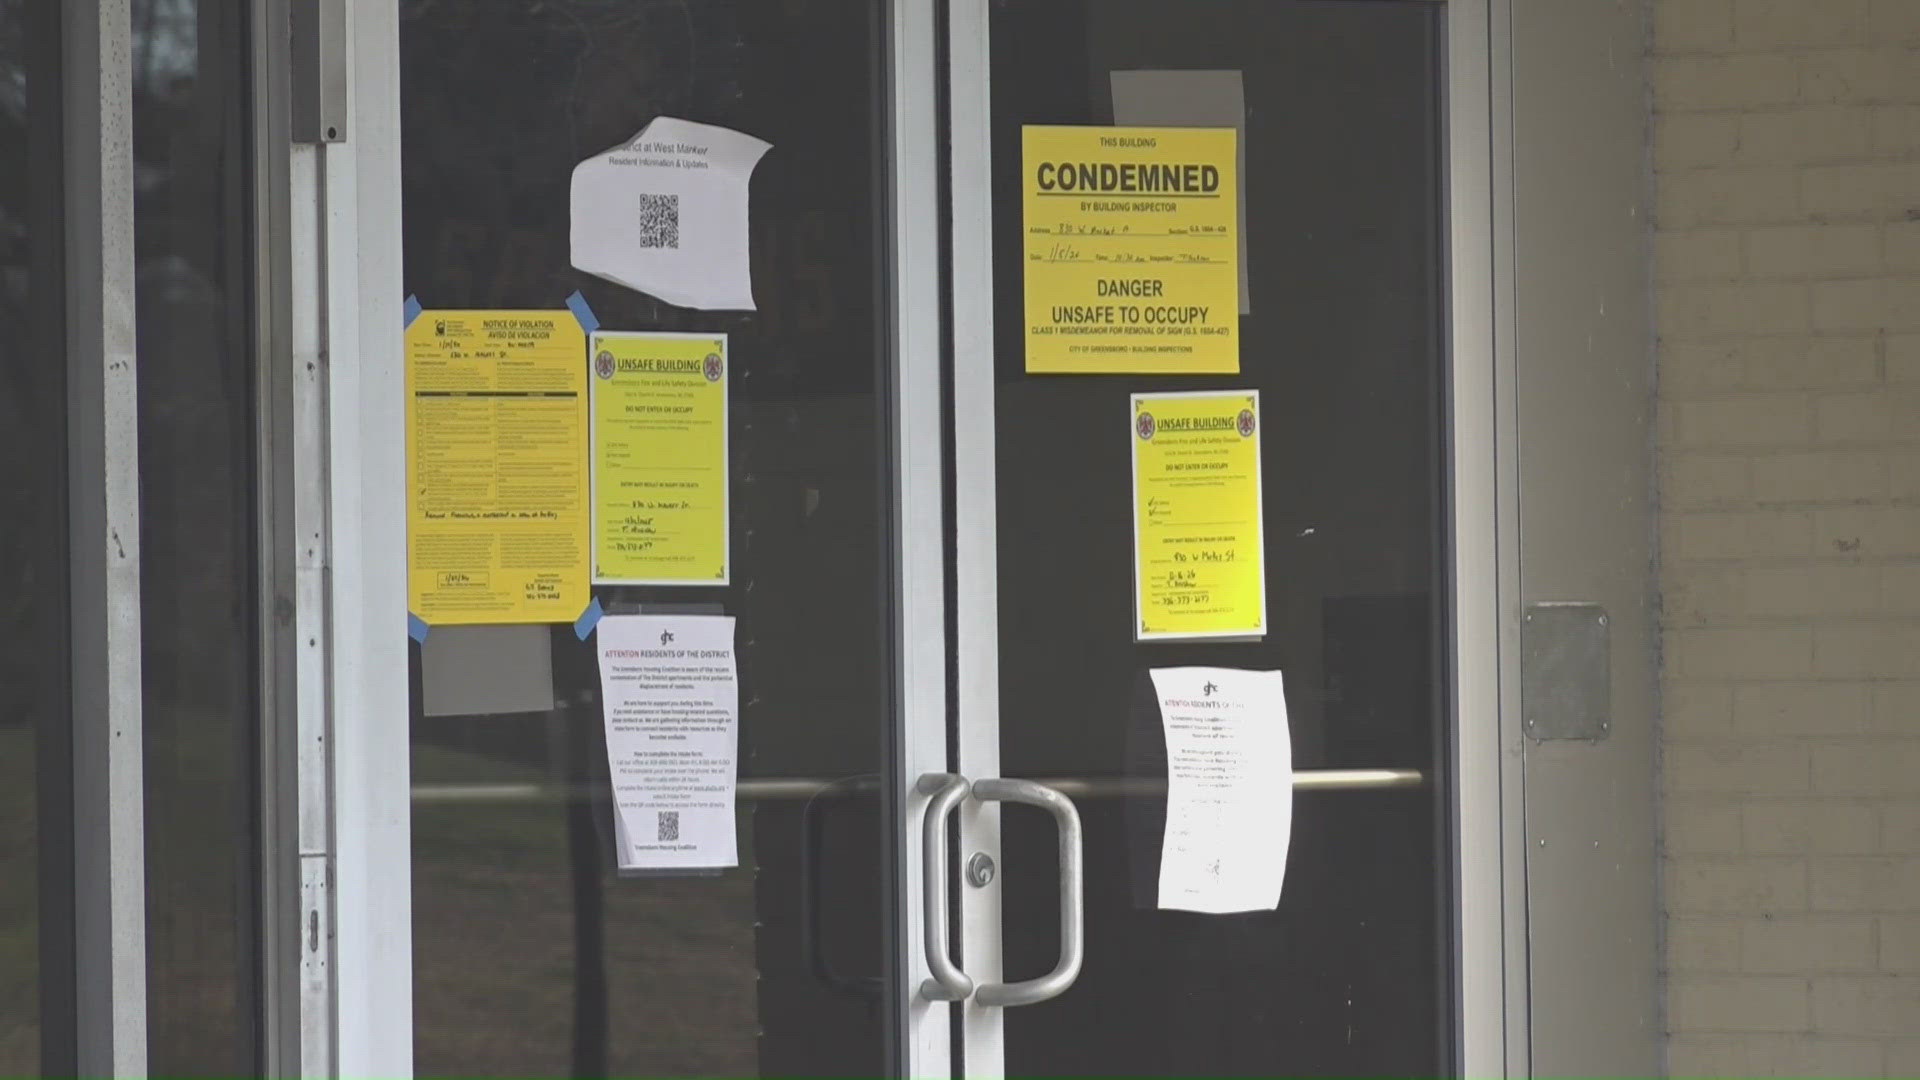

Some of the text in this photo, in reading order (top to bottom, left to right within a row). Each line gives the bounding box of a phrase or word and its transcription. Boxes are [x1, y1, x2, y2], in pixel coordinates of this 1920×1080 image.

[1100, 137, 1156, 148] THIS BUILDING
[653, 142, 675, 153] West
[677, 143, 708, 155] Market
[609, 156, 638, 166] Resident
[639, 157, 674, 167] Information
[682, 158, 709, 169] Updates
[1037, 162, 1219, 192] CONDEMNED
[1081, 202, 1177, 213] BY BUILDING INSPECTOR
[1097, 279, 1163, 297] DANGER
[1052, 306, 1209, 324] UNSAFE TO OCCUPY
[483, 320, 507, 329] NOTICE
[509, 320, 517, 329] OF
[519, 320, 554, 329] VIOLATION
[488, 331, 507, 339] AVISO
[1032, 326, 1052, 335] CLASS
[1060, 327, 1107, 335] MISDEMEANOR
[1109, 327, 1122, 335] FOR
[1124, 327, 1155, 335] REMOVAL
[1156, 327, 1166, 335] OF
[1167, 327, 1182, 335] SIGN
[618, 358, 700, 371] UNSAFE BUILDING
[672, 406, 693, 414] OCCUPY
[1157, 417, 1235, 429] UNSAFE BUILDING
[605, 650, 639, 658] ATTENTION
[640, 650, 676, 658] RESIDENTS
[677, 650, 685, 658] OF
[687, 650, 699, 658] THE
